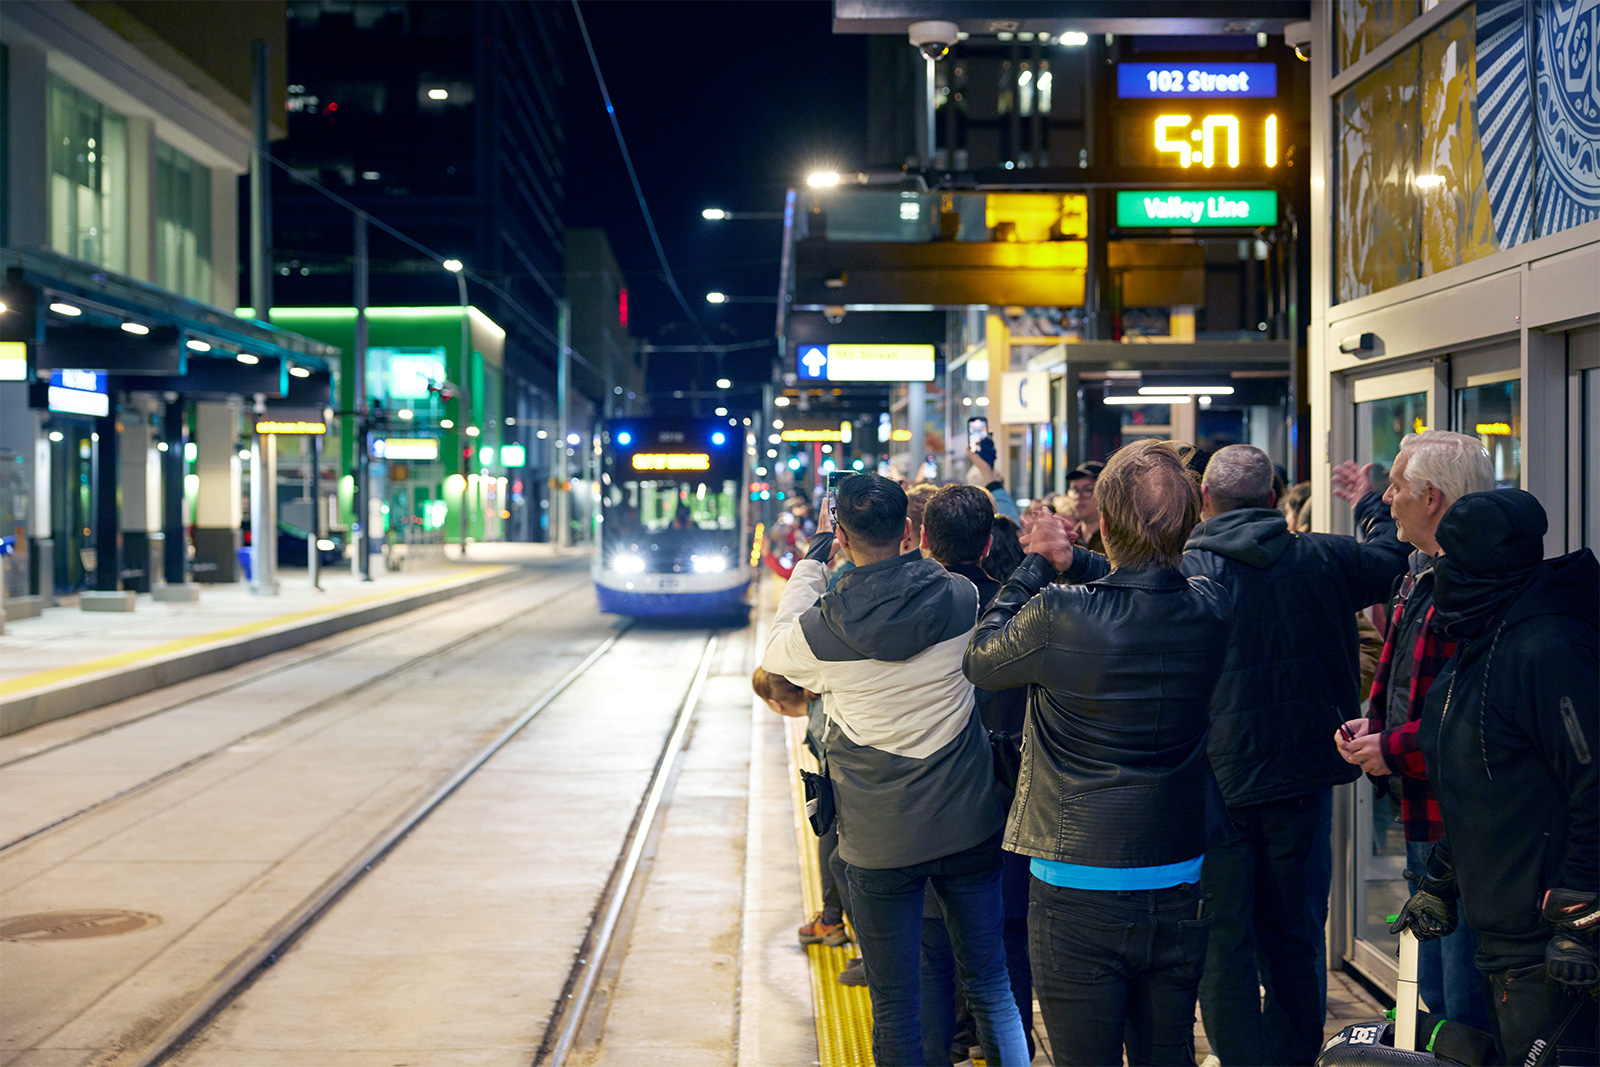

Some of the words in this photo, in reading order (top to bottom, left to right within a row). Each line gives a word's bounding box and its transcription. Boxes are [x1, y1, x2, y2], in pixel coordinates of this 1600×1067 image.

[1147, 70, 1184, 92] 102
[1187, 70, 1250, 92] Street
[1143, 196, 1205, 223] Valley
[1207, 196, 1250, 218] Line
